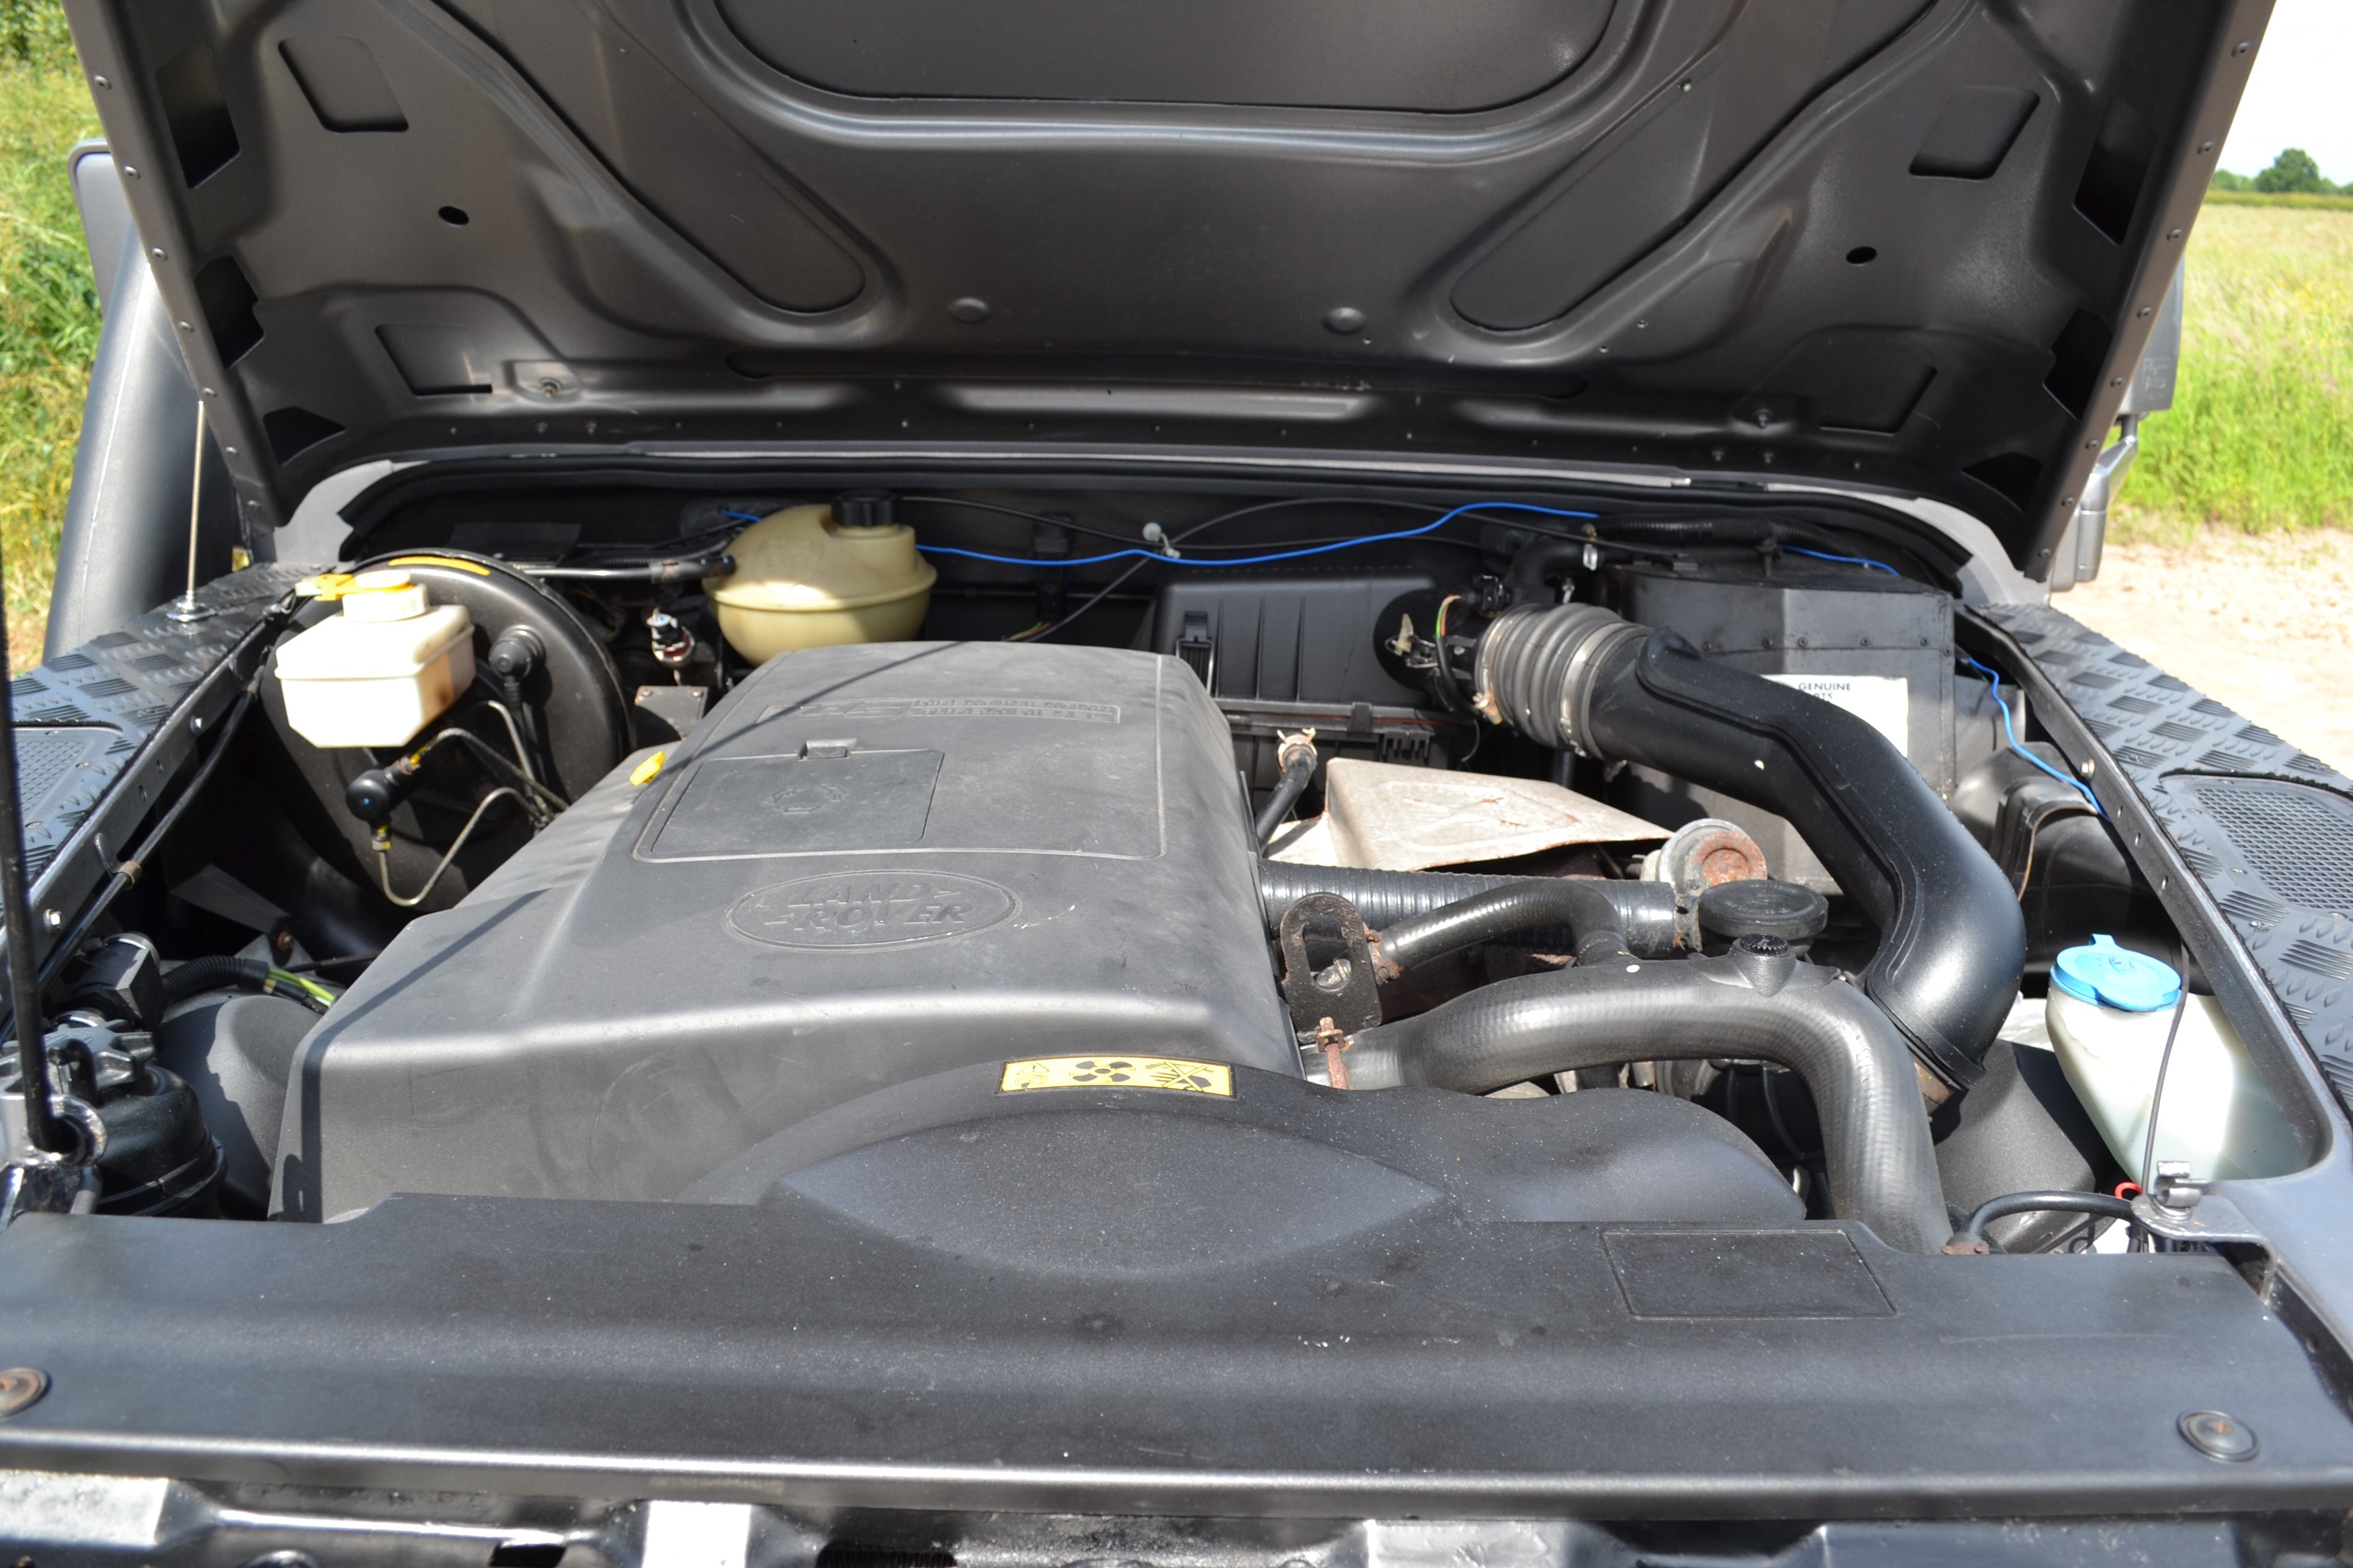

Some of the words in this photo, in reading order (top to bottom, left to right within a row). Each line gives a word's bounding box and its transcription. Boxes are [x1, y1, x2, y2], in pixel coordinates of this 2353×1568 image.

[1798, 682, 1851, 691] GENUINE
[787, 881, 932, 906] LAND
[794, 902, 973, 931] ROVER
